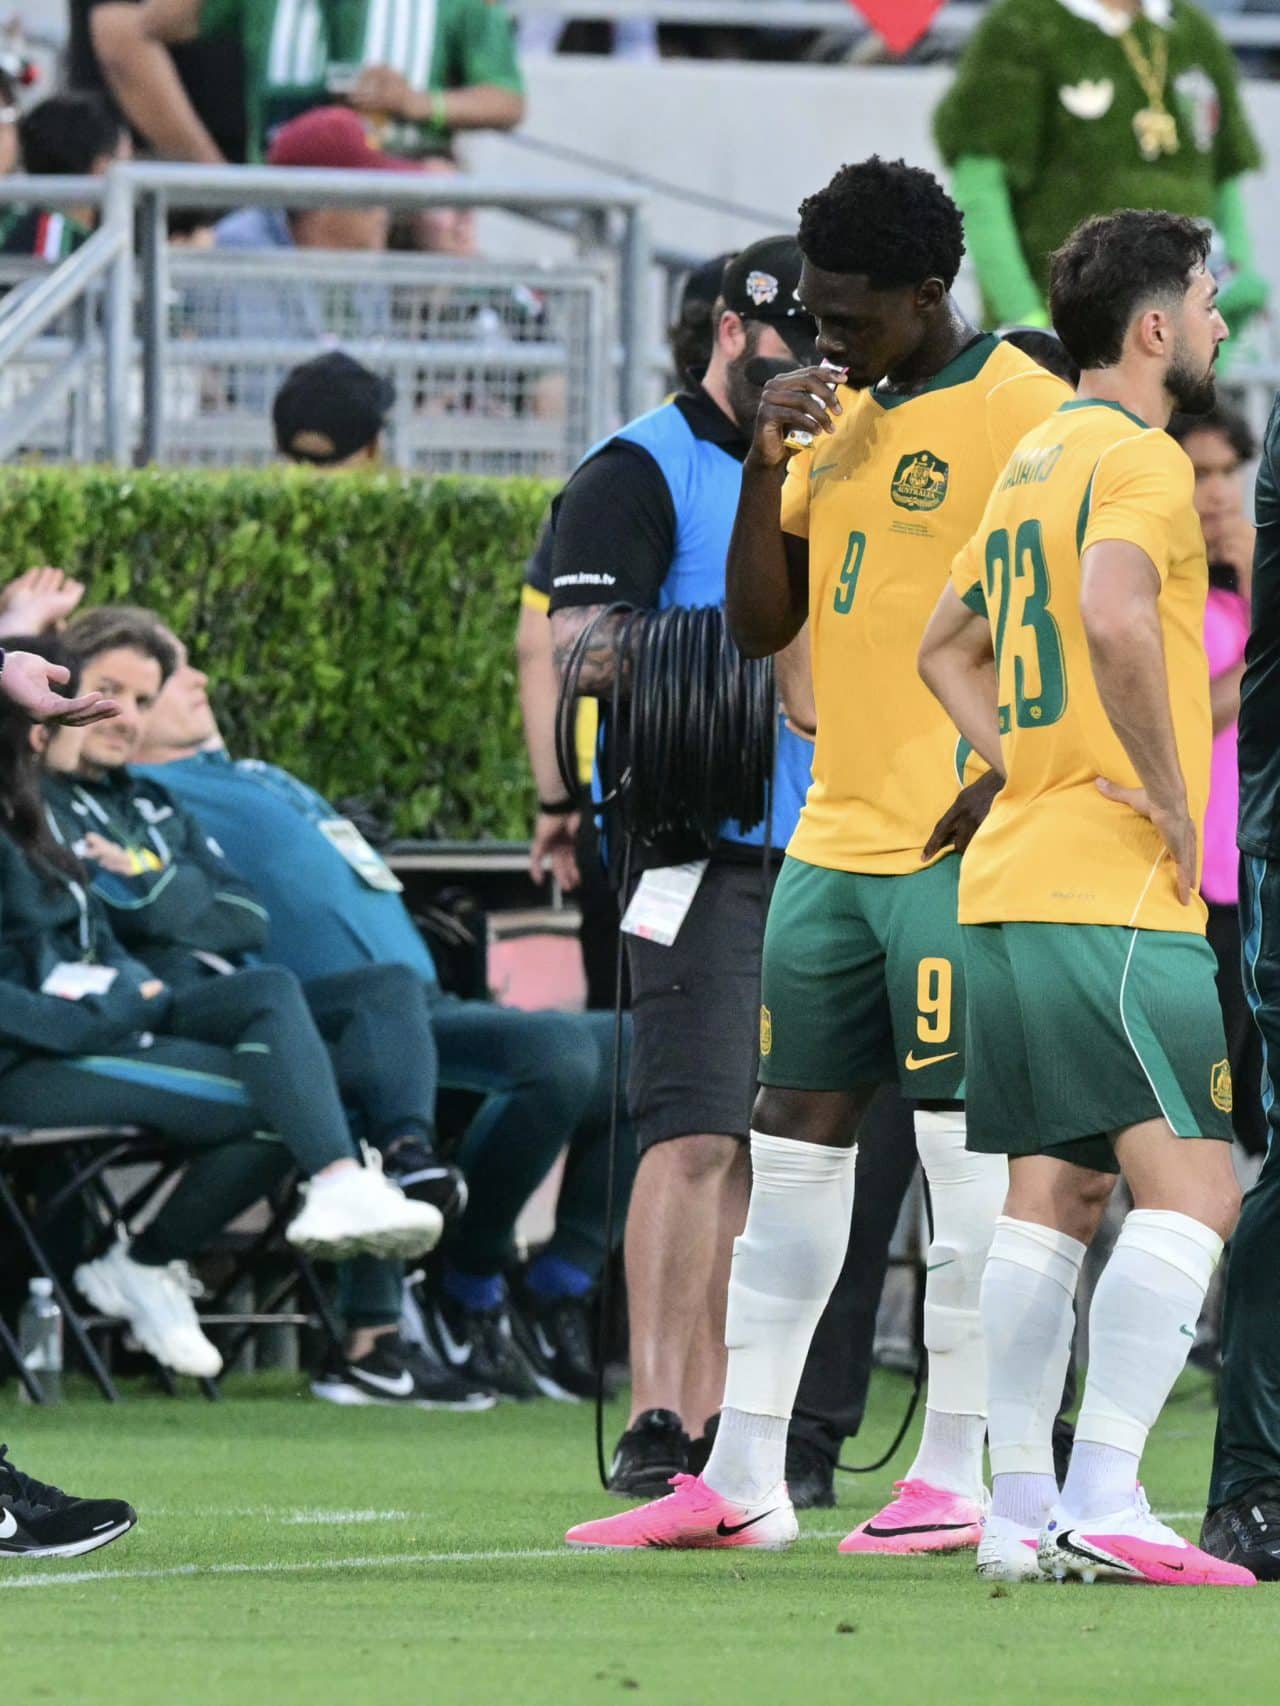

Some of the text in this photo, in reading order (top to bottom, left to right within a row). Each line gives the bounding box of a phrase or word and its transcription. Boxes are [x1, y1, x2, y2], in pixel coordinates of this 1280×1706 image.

[833, 530, 867, 615] 9
[985, 518, 1068, 736] 23
[917, 957, 952, 1044] 9
